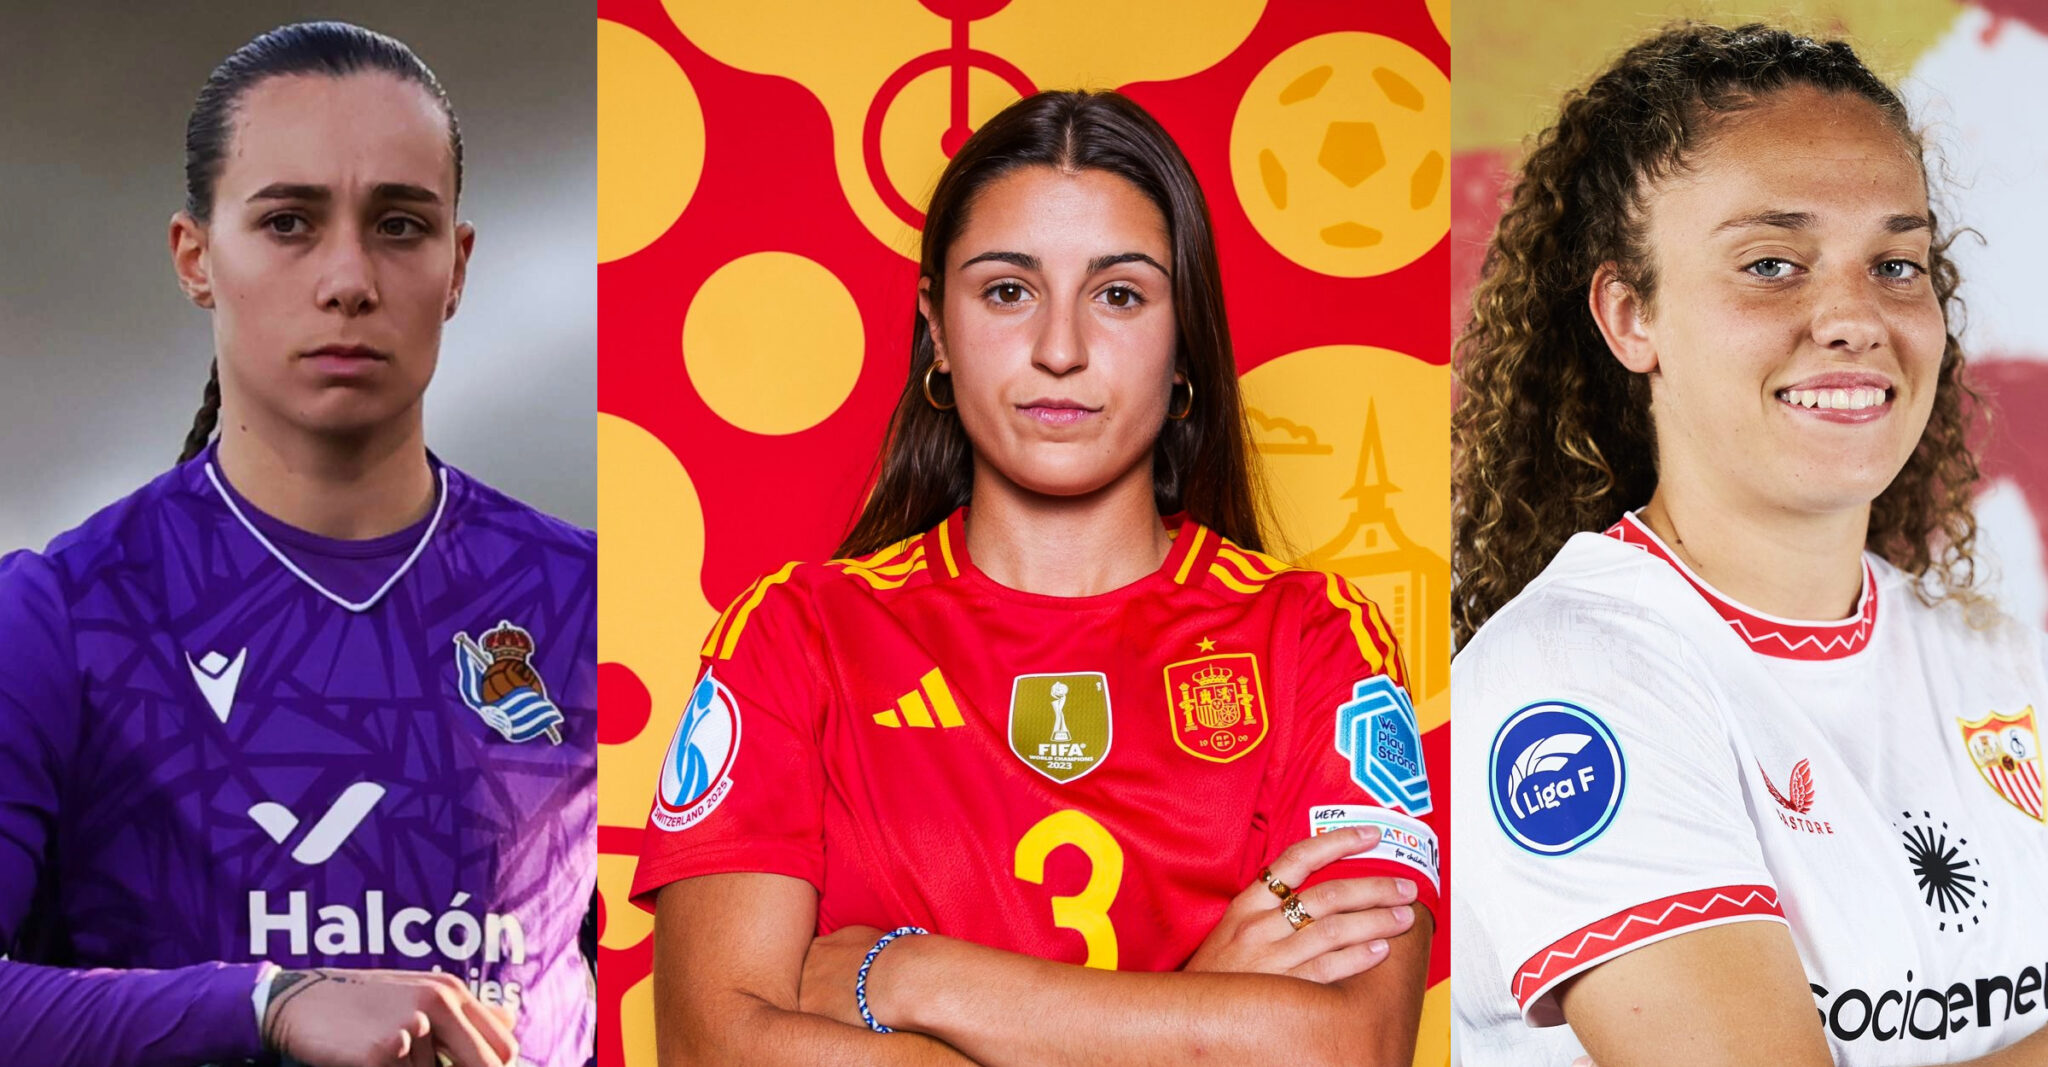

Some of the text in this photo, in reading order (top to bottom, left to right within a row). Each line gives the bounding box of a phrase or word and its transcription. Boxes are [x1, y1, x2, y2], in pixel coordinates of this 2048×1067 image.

[1378, 715, 1397, 734] We
[1378, 731, 1404, 756] Play
[1047, 762, 1072, 770] 2023
[1378, 745, 1417, 777] Strong
[1522, 765, 1595, 815] Liga F
[654, 780, 728, 828] SWITZERLAND 2025
[1314, 808, 1346, 820] UEFA
[1775, 808, 1834, 835] ASTORE
[1394, 847, 1405, 859] for
[1014, 809, 1124, 971] 3
[248, 890, 526, 965] Halcón
